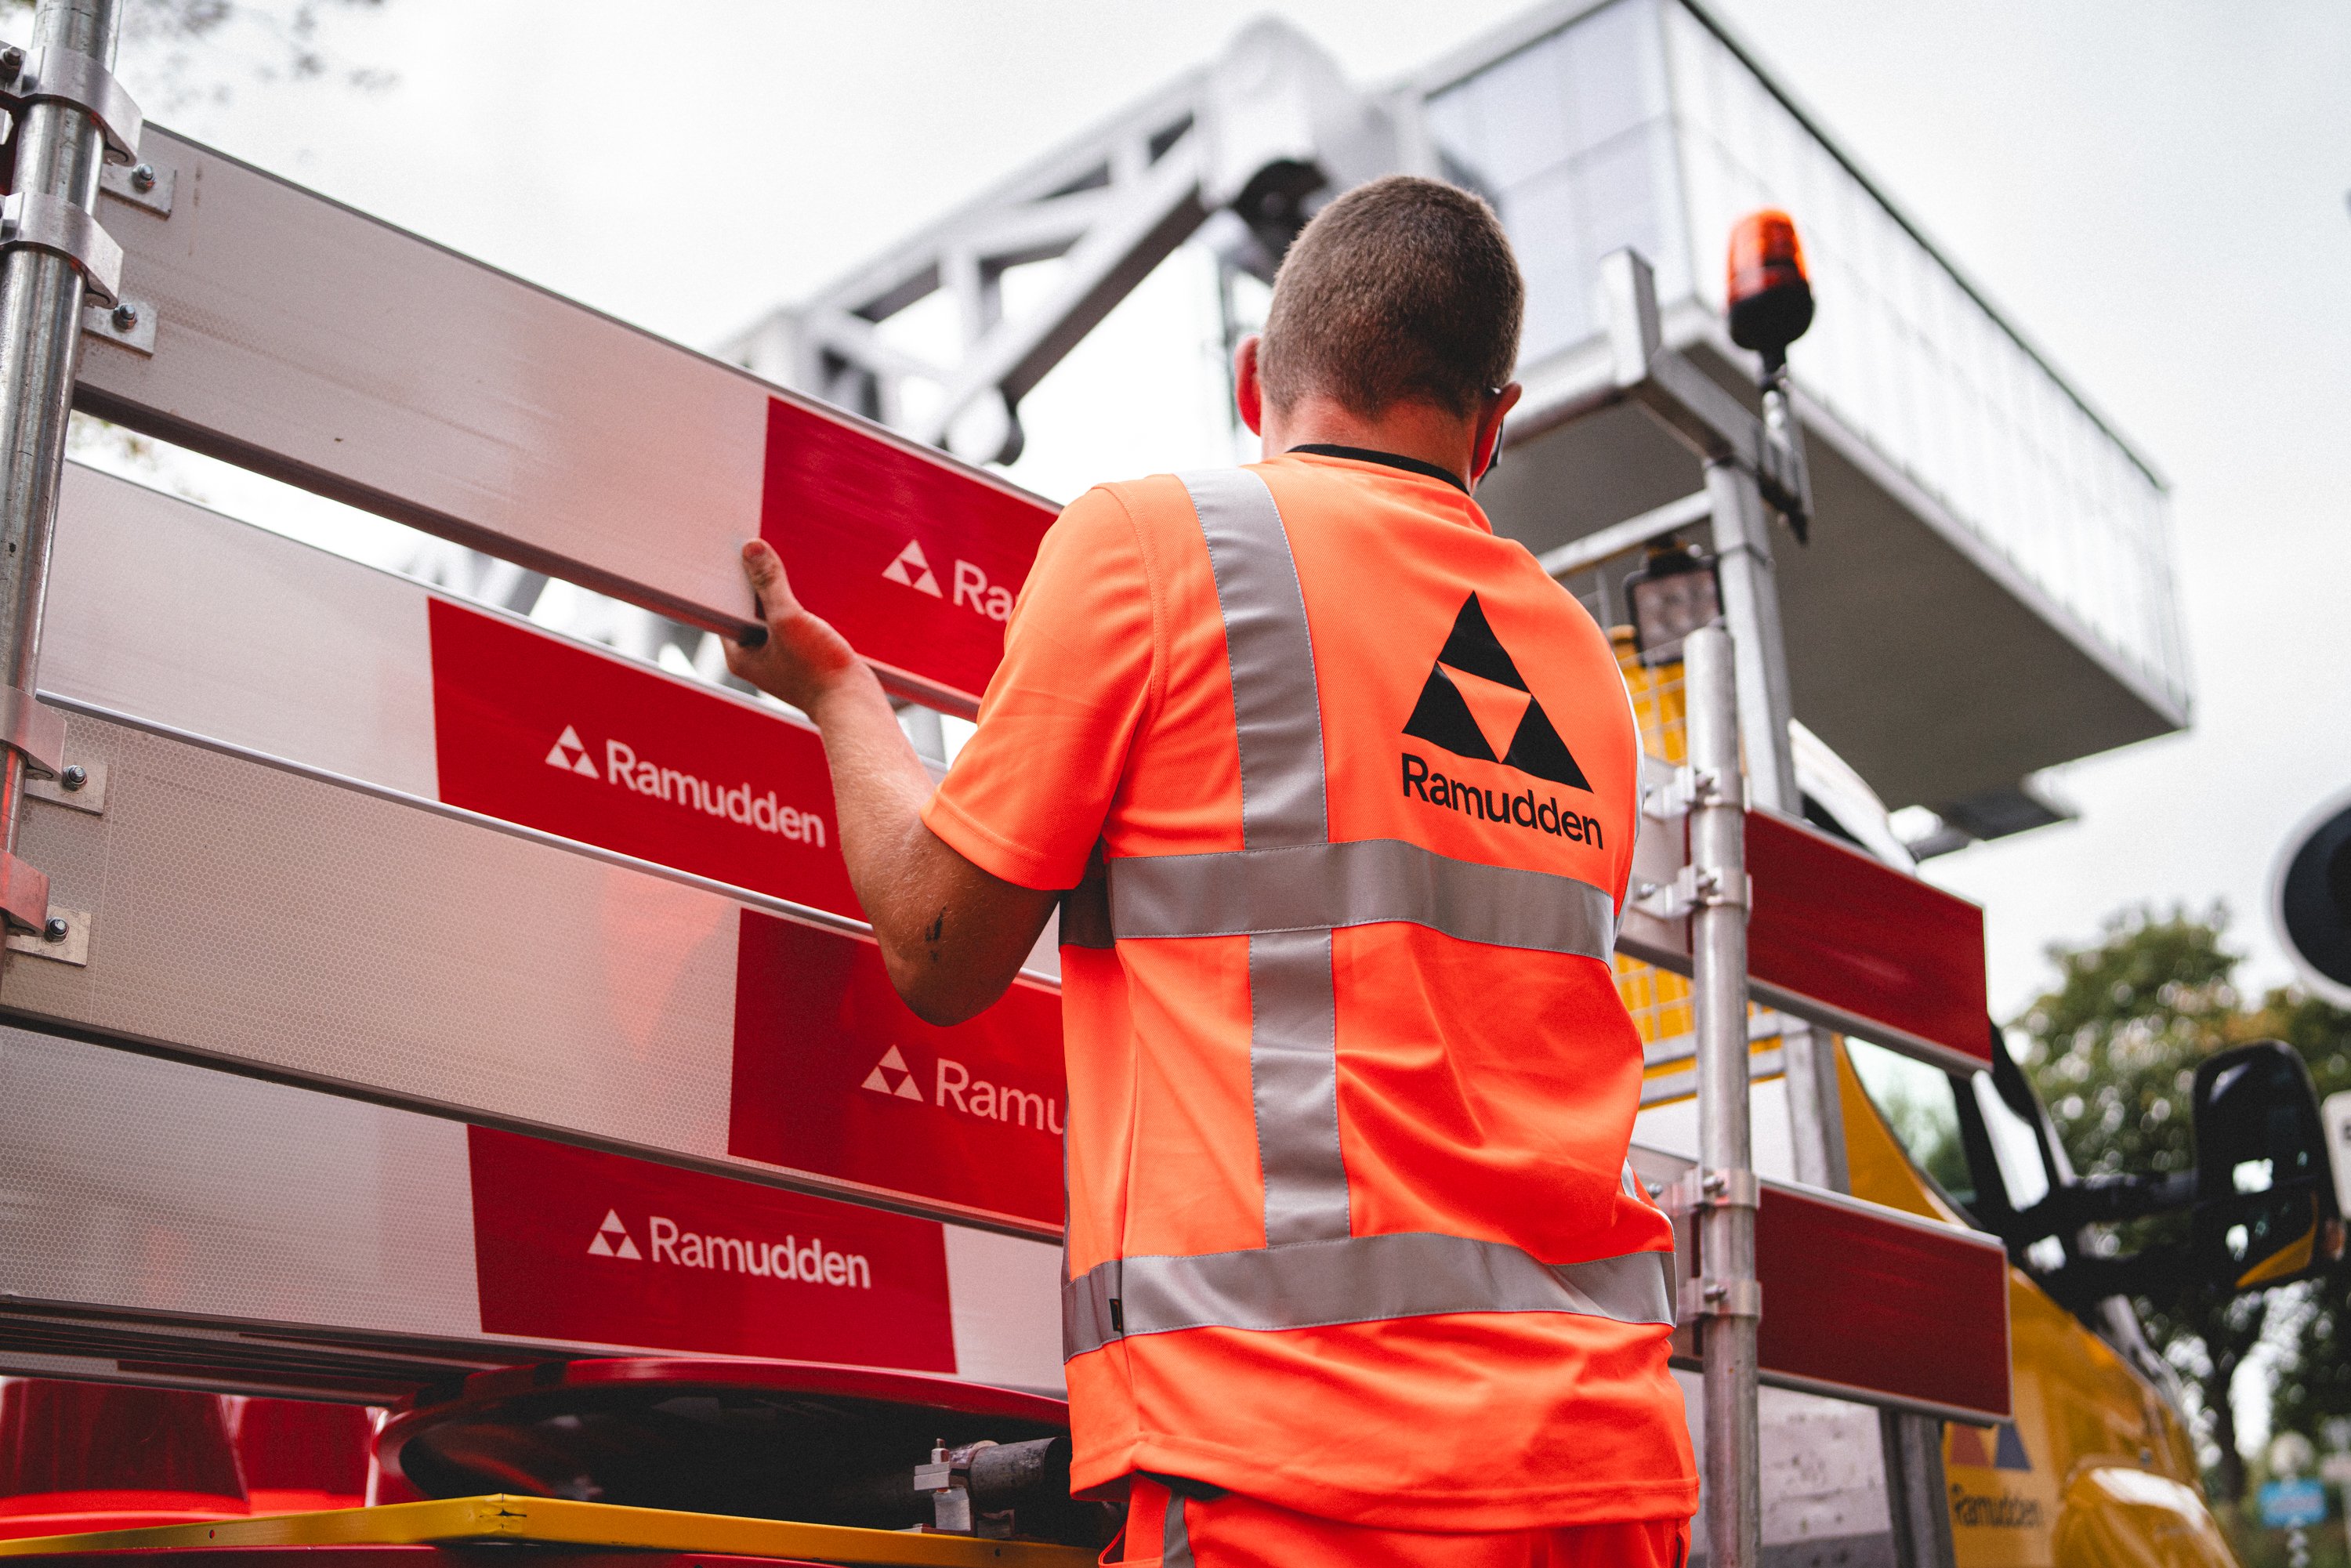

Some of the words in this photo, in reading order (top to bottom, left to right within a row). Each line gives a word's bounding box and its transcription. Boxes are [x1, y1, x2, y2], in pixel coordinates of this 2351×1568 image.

[953, 559, 1019, 621] Ra
[607, 739, 825, 847] Ramudden
[1402, 753, 1603, 849] Ramudden
[650, 1216, 871, 1289] Ramudden
